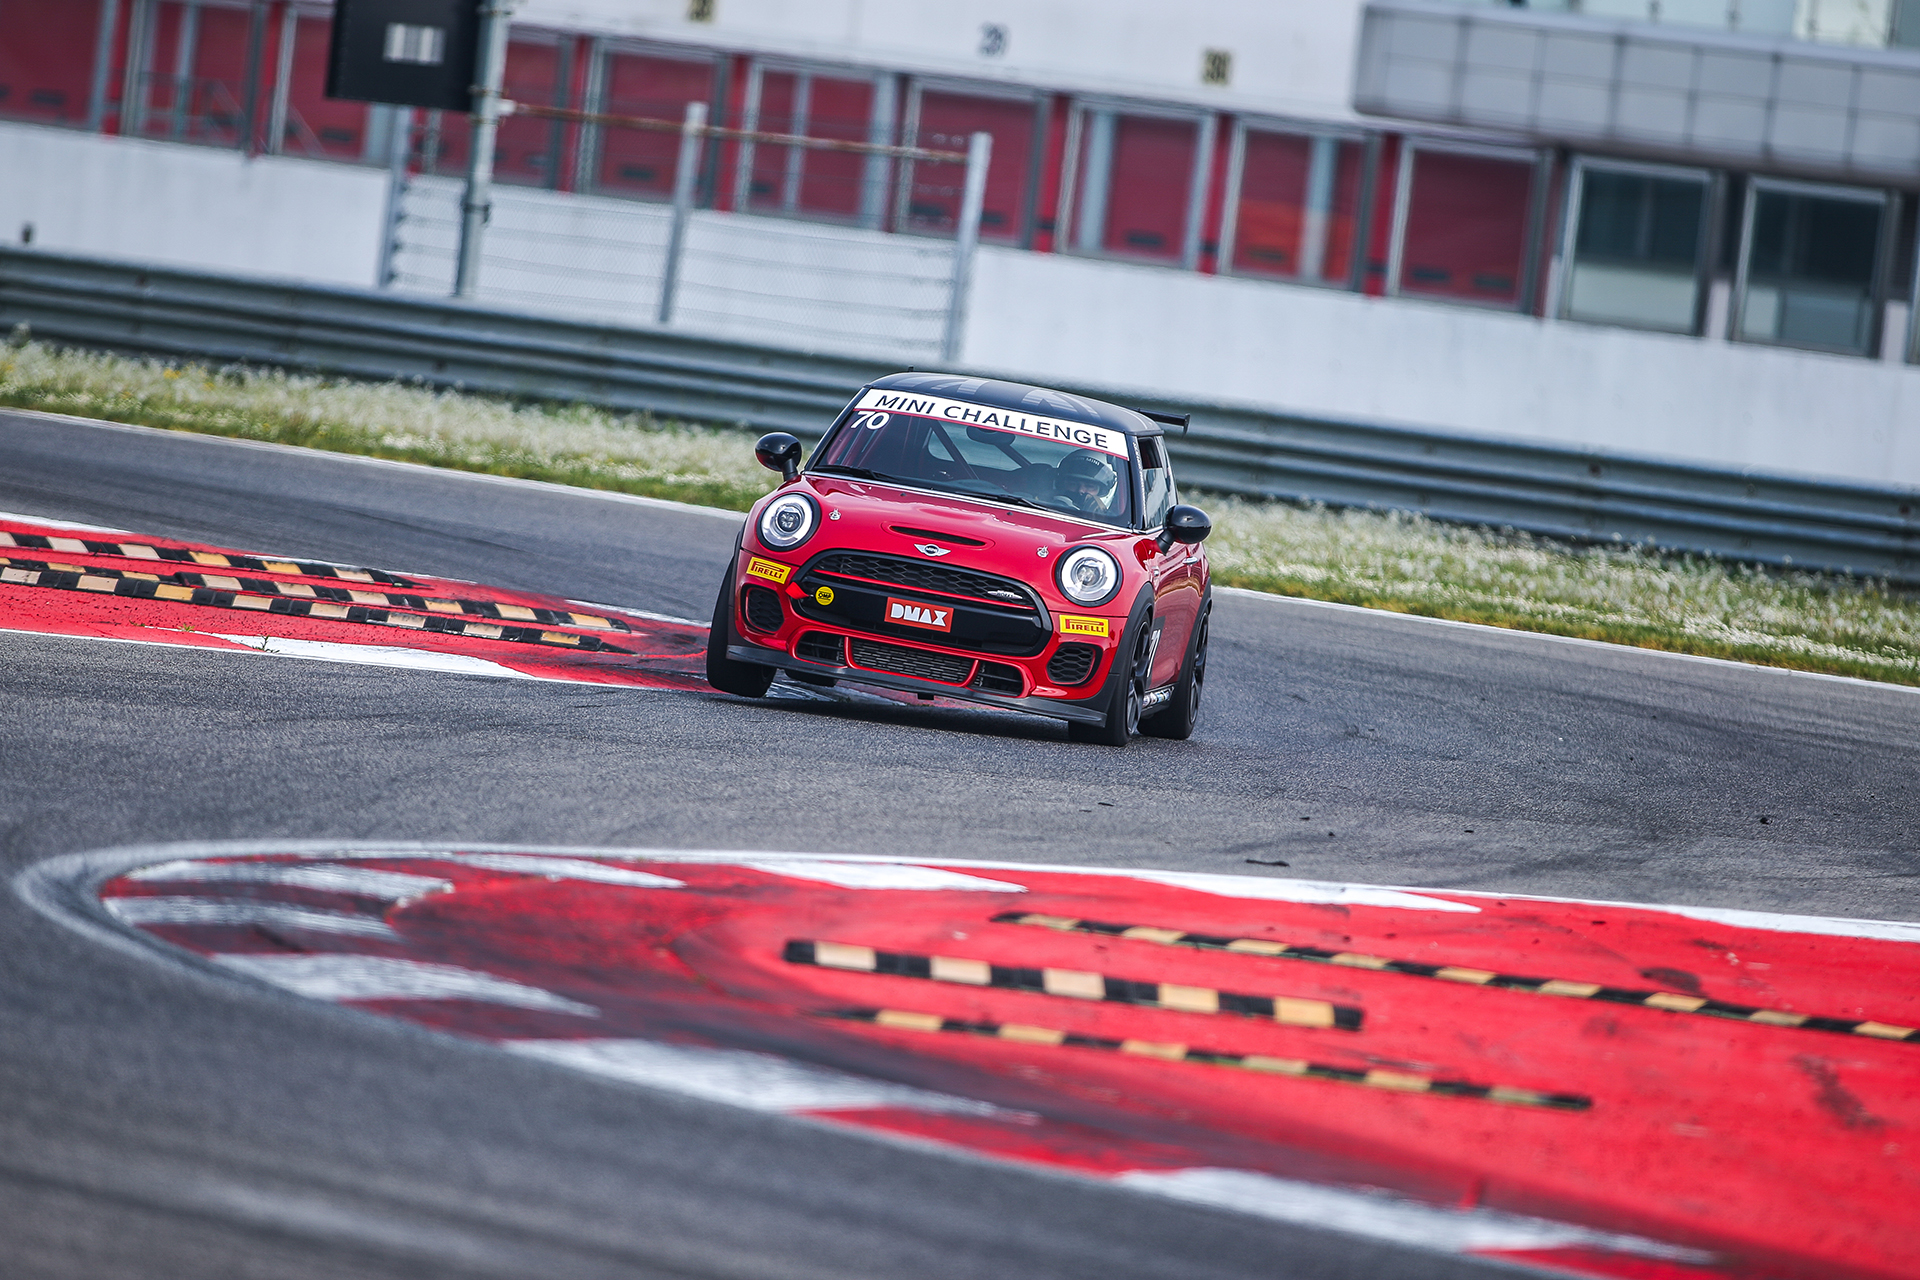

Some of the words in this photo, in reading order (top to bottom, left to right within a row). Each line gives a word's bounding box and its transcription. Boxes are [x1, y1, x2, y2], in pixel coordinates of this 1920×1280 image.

[851, 410, 891, 431] 70
[874, 395, 936, 415] MINI
[943, 405, 1108, 449] CHALLENGE
[750, 560, 785, 579] PIRELLI
[890, 602, 948, 627] DMAX
[1065, 618, 1105, 633] PIRELLI
